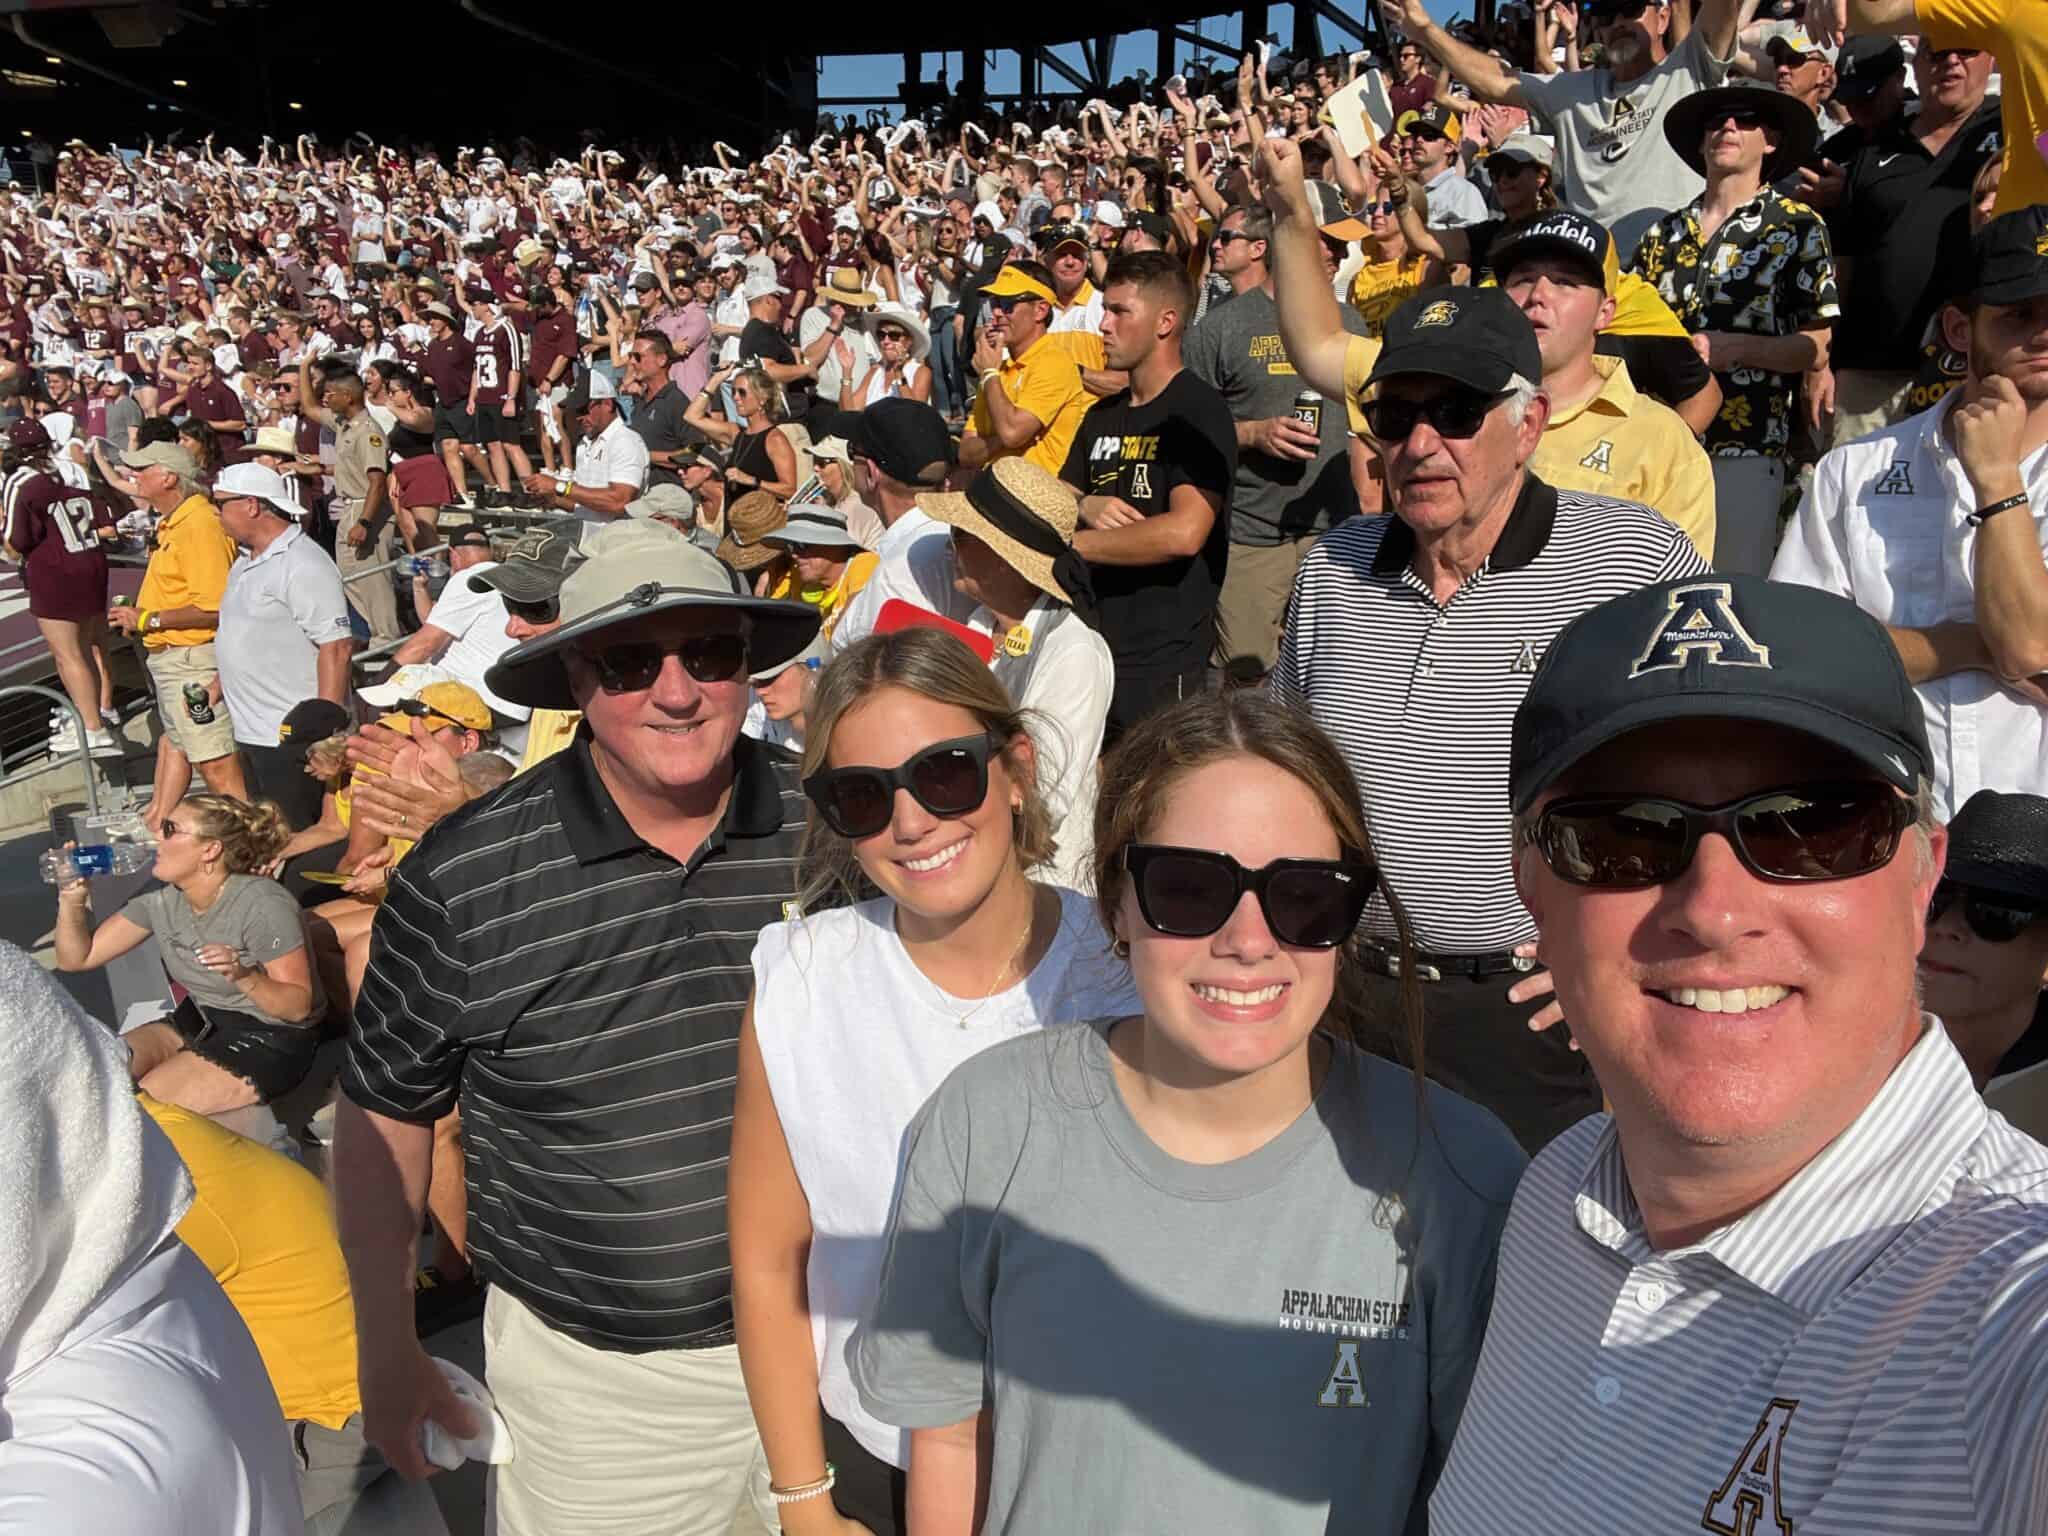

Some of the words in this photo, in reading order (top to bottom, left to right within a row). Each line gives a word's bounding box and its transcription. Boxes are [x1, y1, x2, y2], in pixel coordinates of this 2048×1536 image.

[1089, 435, 1121, 460] APP
[1579, 439, 1614, 475] A
[1131, 463, 1153, 498] A
[1874, 460, 1914, 496] A
[47, 496, 101, 553] 12
[1628, 583, 1773, 680] A
[1511, 639, 1538, 672] A
[1281, 1288, 1371, 1324] APPALACHIAN
[1317, 1339, 1370, 1408] A
[1701, 1396, 1800, 1536] A
